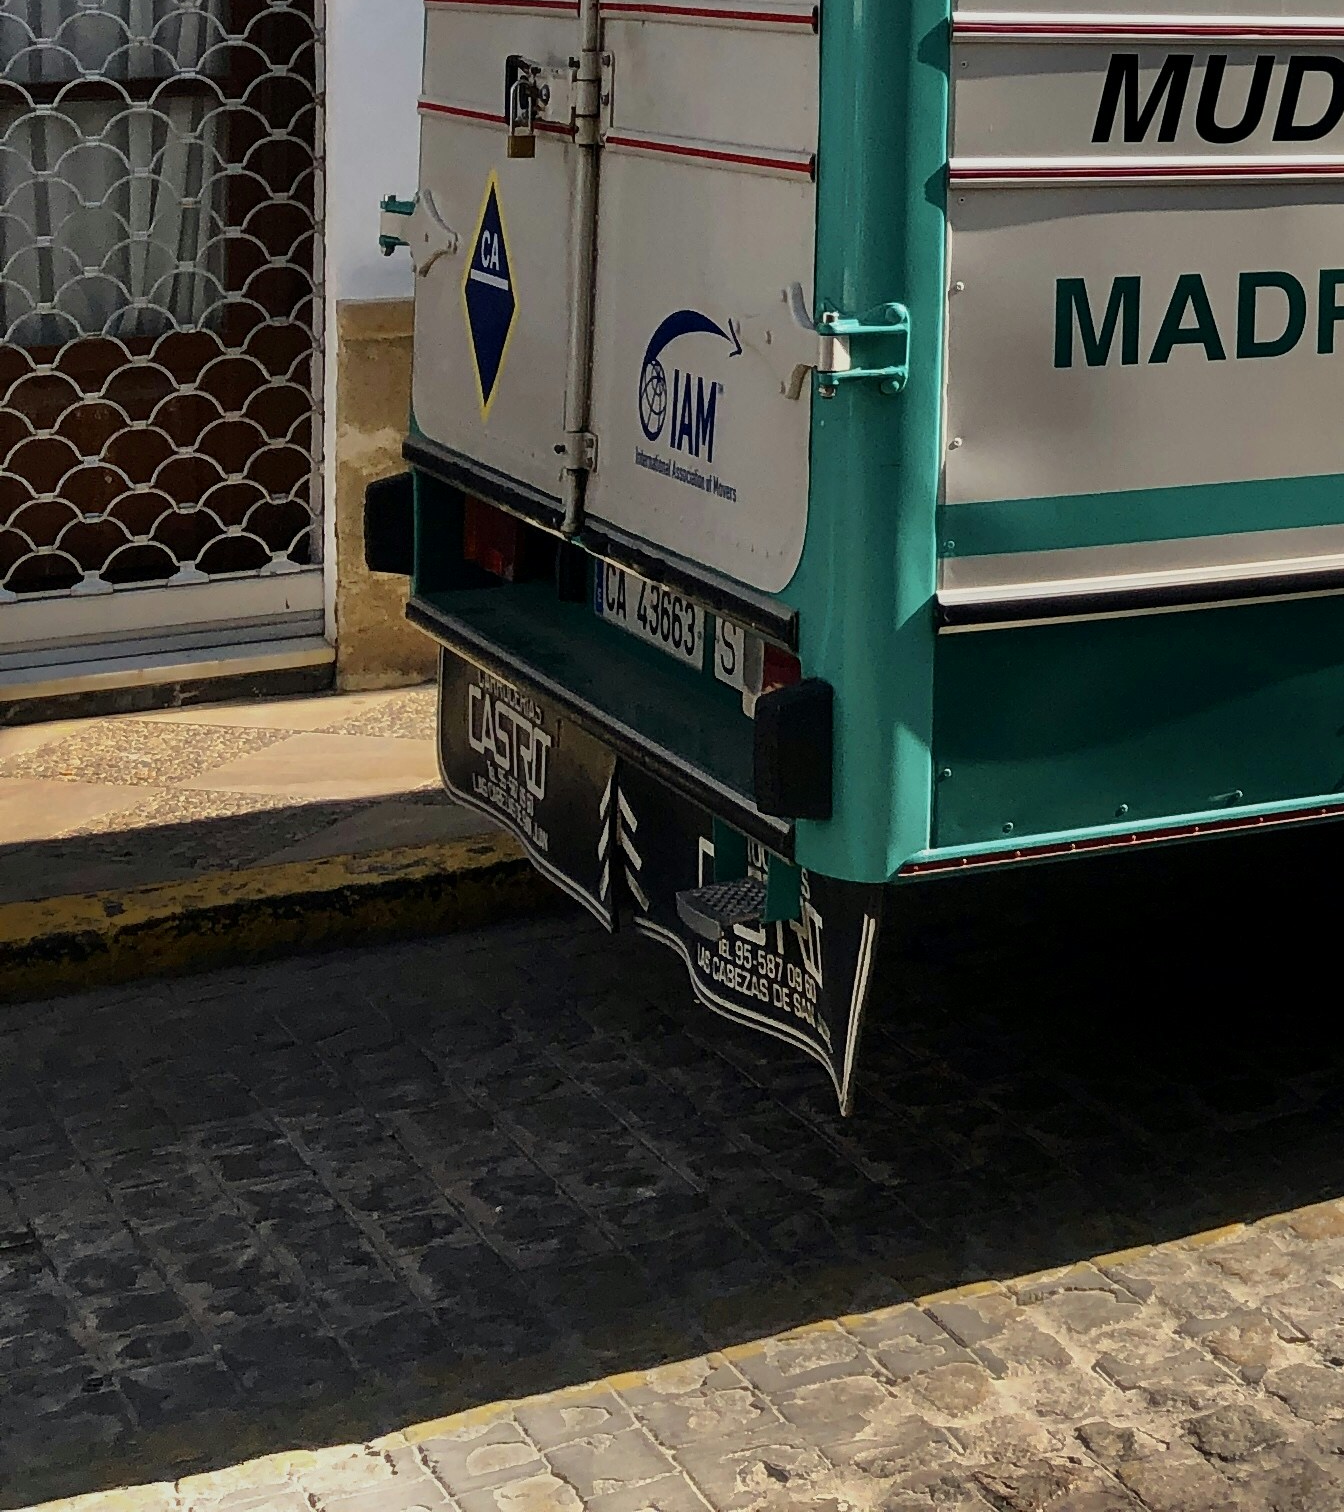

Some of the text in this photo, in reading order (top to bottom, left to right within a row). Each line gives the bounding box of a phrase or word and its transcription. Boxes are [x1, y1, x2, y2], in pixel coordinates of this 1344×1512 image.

[481, 229, 500, 271] CA
[670, 368, 717, 464] IAM
[605, 563, 696, 657] CA 43663
[720, 619, 737, 676] S
[468, 683, 551, 801] CASTRO
[712, 953, 769, 1003] CABEZAS
[772, 983, 791, 1013] DE
[735, 941, 784, 982] 95-587
[787, 963, 803, 993] 09
